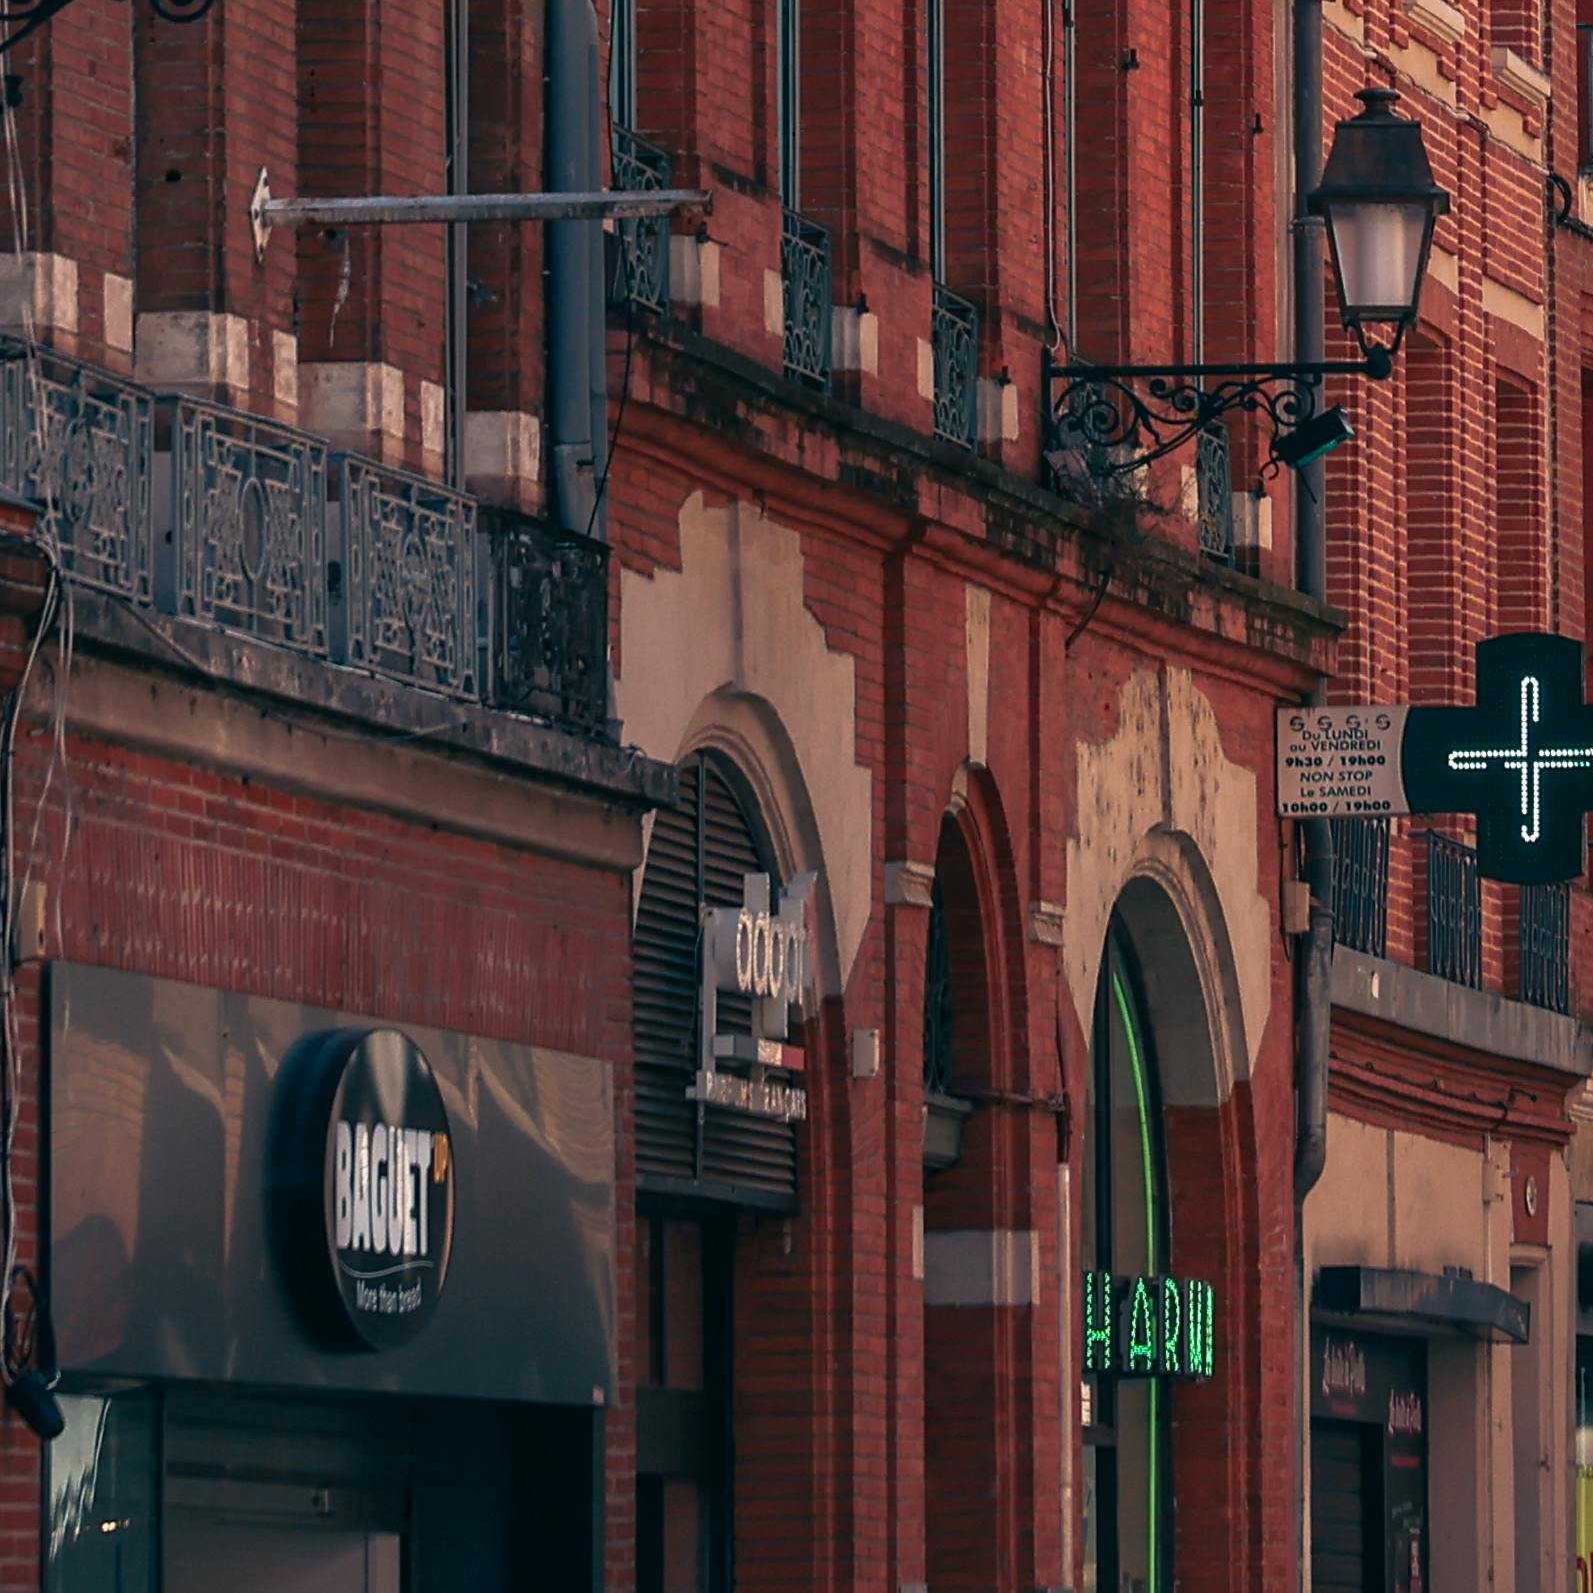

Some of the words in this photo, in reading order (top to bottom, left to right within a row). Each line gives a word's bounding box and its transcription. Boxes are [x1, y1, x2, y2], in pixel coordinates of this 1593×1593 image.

[1302, 730, 1320, 741] Du
[1325, 729, 1368, 740] LUNDI
[1311, 740, 1381, 751] VENDREDI
[1285, 757, 1323, 767] 9h30
[1340, 755, 1386, 766] 19h00
[1300, 771, 1334, 782] NON
[1338, 770, 1373, 781] STOP
[1300, 787, 1315, 798] Le
[1319, 786, 1371, 796] SAMEDI
[1282, 802, 1328, 813] 10h00
[1345, 800, 1391, 811] 19h00
[335, 1119, 432, 1256] BAGUET
